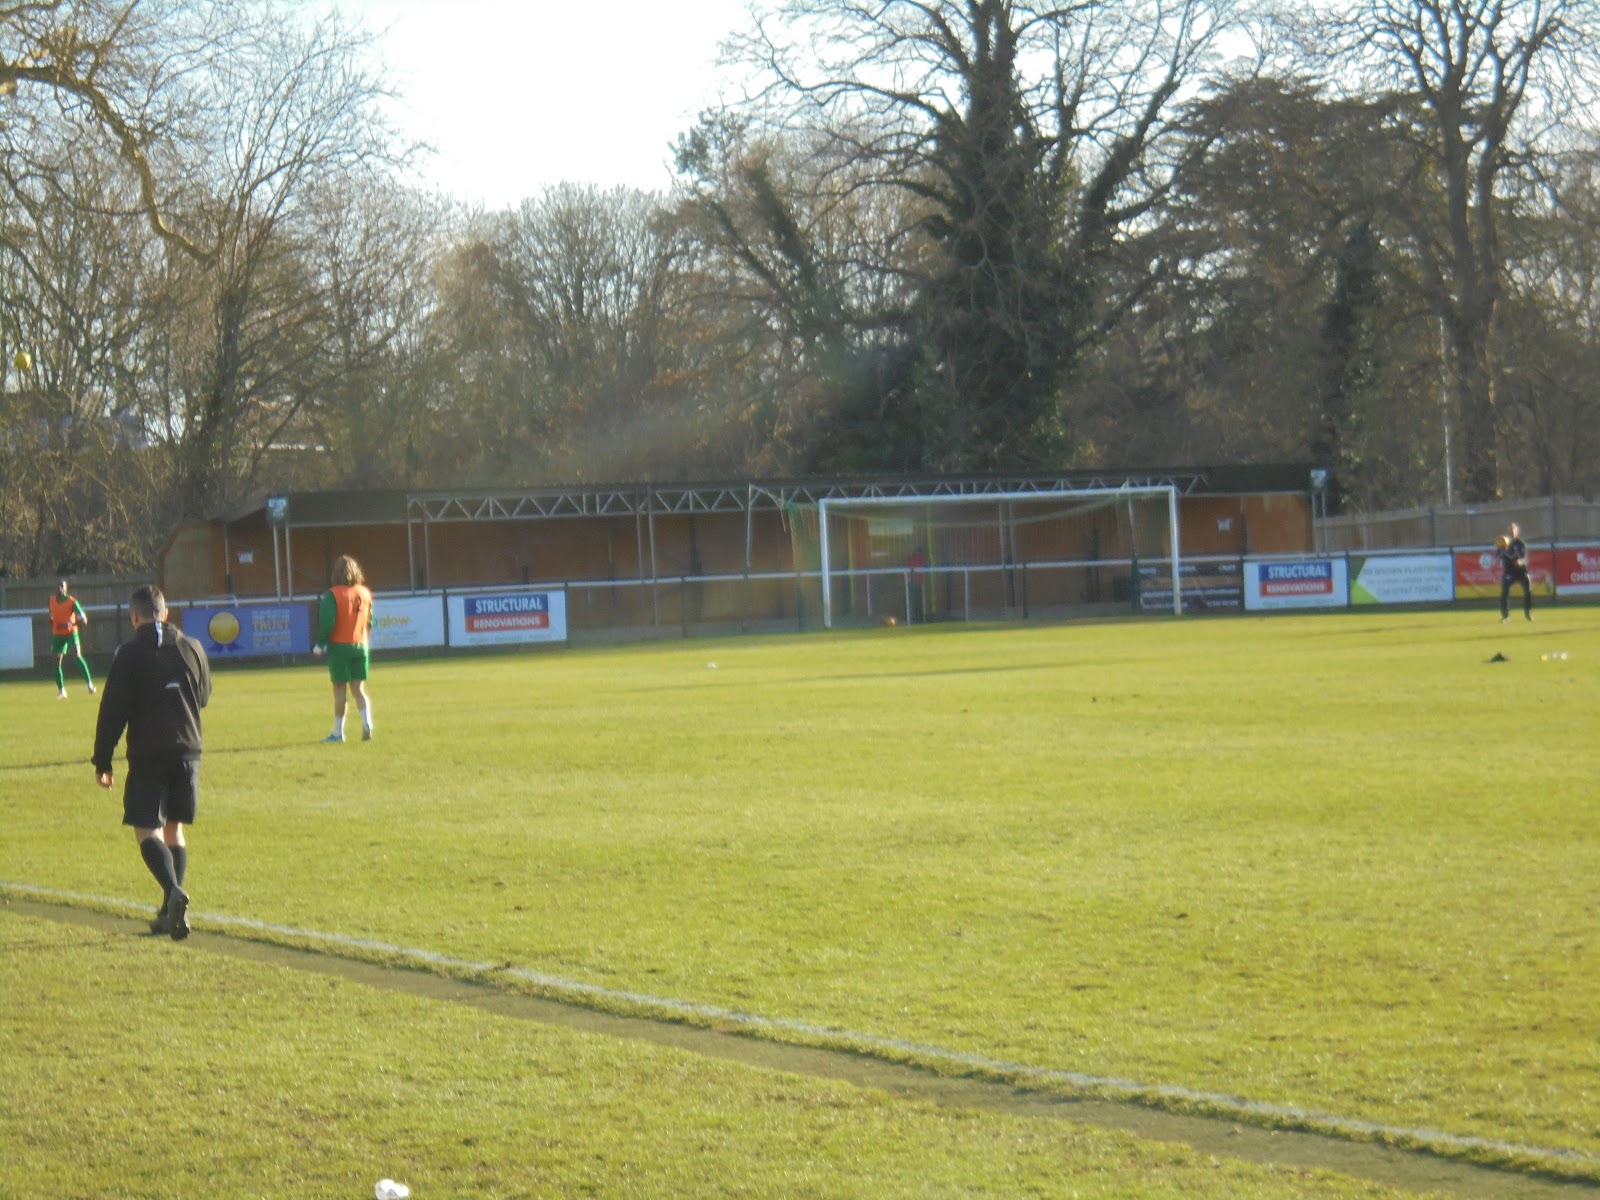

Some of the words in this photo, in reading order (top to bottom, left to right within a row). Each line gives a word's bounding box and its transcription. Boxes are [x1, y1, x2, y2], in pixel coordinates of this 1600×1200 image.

[1267, 563, 1327, 580] STRUCTURAL
[1265, 581, 1325, 594] RENOVATIONS
[475, 596, 543, 614] STRUCTURAL
[252, 618, 289, 632] TRUST
[473, 615, 541, 629] RENOVATIONS
